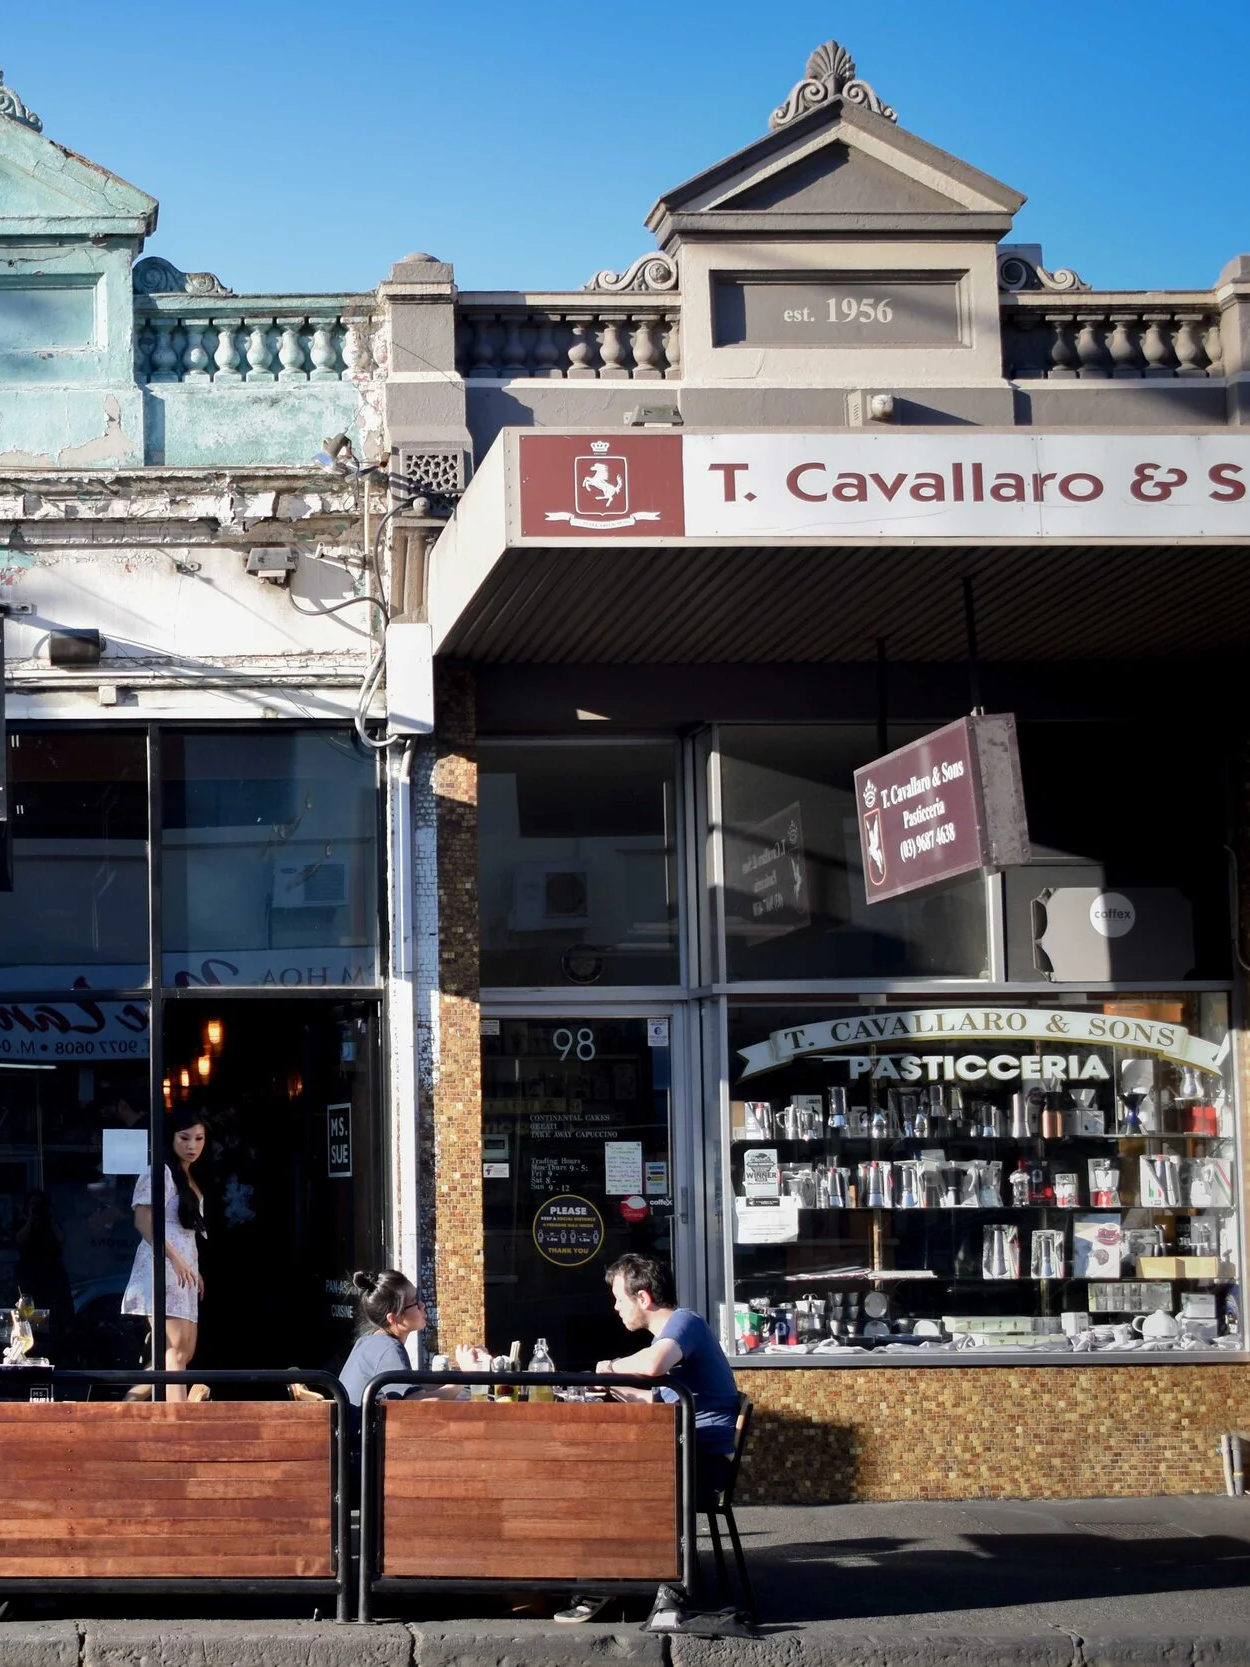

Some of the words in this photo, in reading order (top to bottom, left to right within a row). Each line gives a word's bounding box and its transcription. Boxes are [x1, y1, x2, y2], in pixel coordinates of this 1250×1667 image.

[783, 307, 815, 322] est.
[825, 297, 893, 323] 1956
[708, 462, 757, 502] T.
[786, 462, 1104, 503] Cavallaro
[1130, 462, 1188, 503] &
[880, 789, 890, 809] T.
[890, 776, 931, 805] Cavallaro
[932, 766, 941, 788] &
[941, 760, 964, 783] Sons
[902, 797, 946, 829] Pasticceria
[900, 838, 916, 863] (03)
[916, 830, 935, 854] 9687
[935, 822, 956, 846] 4638
[1094, 908, 1131, 919] coffex
[552, 1027, 596, 1062] 98
[783, 1029, 815, 1051] T.
[830, 1012, 1027, 1043] CAVALLARO
[1044, 1013, 1069, 1033] &
[1088, 1017, 1175, 1048] SONS
[849, 1054, 1110, 1081] PASTICCERIA
[330, 1116, 348, 1137] MS.
[531, 1130, 550, 1138] TAKE
[553, 1130, 571, 1138] AWAY
[575, 1130, 618, 1138] CAPUCCINO
[330, 1144, 348, 1164] SUE
[530, 1157, 558, 1165] Trading
[550, 1206, 587, 1215] PLEASE
[649, 1198, 673, 1207] coffex
